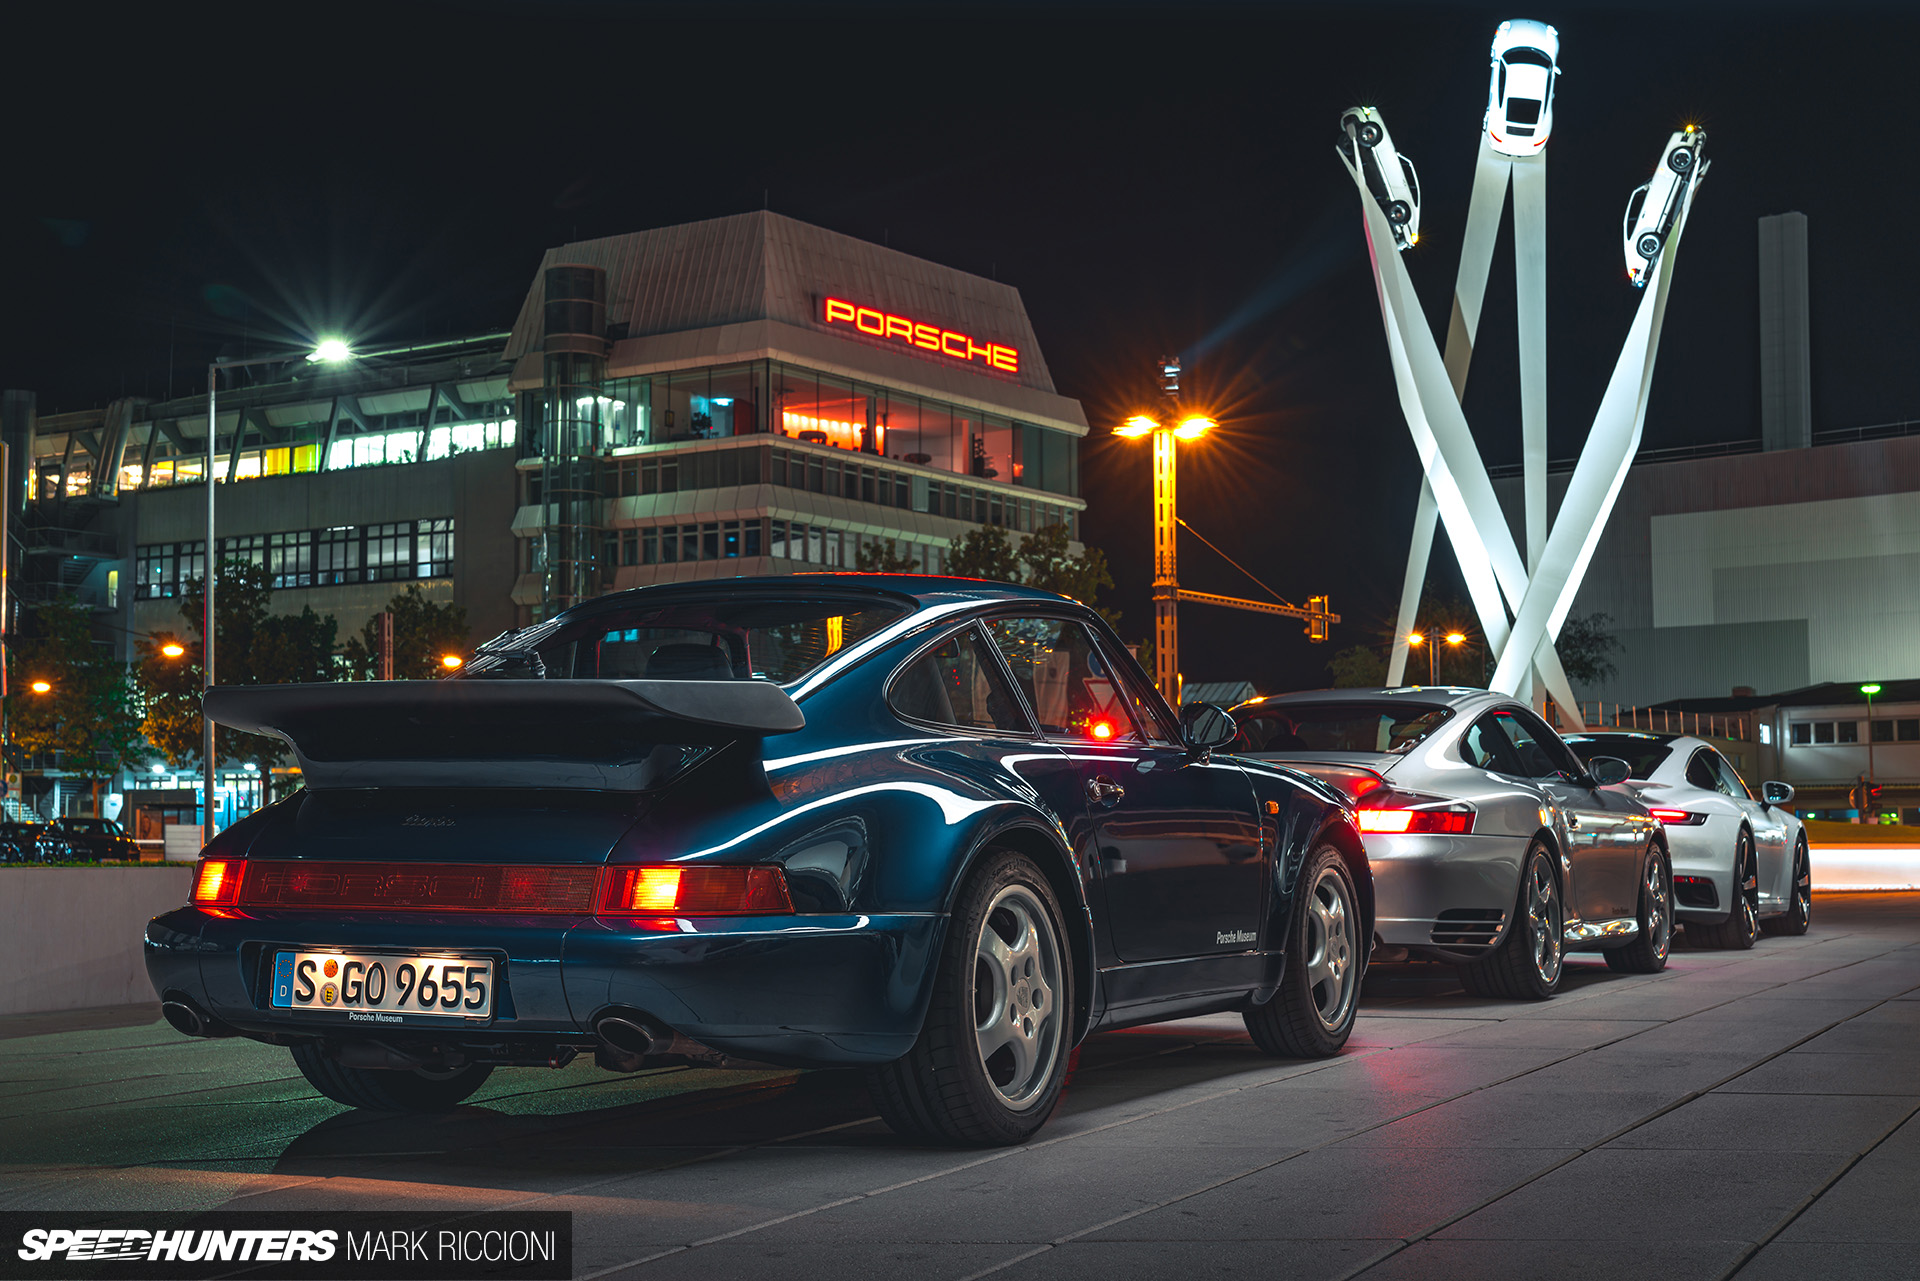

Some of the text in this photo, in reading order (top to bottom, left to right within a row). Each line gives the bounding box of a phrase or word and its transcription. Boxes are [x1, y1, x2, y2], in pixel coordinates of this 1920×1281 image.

[826, 297, 1018, 373] PORSCHE
[1216, 930, 1257, 944] Porsche Museum
[280, 985, 288, 997] D
[295, 959, 317, 1002] S
[341, 961, 387, 1006] GO
[396, 963, 489, 1009] 9655
[349, 1012, 403, 1023] Porsche Museum
